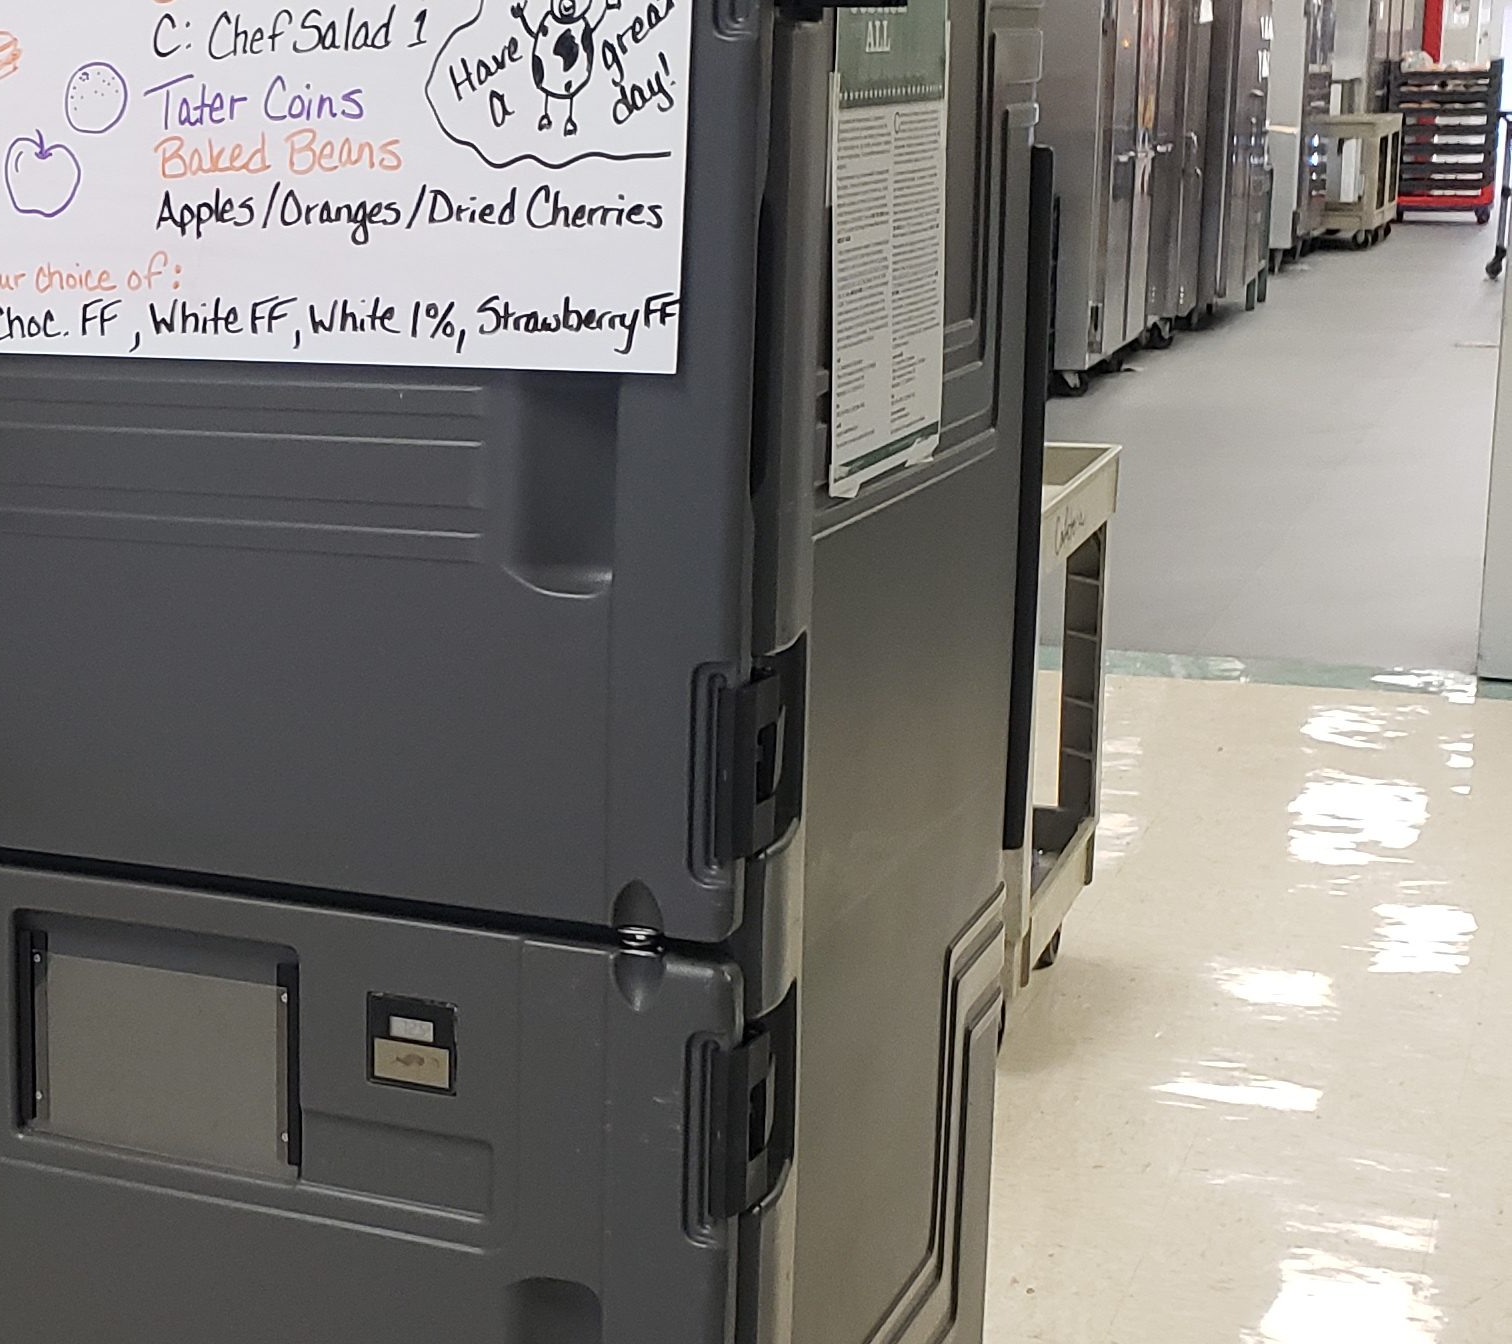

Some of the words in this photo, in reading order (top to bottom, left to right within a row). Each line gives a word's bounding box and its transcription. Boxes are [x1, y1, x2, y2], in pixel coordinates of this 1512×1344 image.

[153, 13, 191, 57] C:
[208, 9, 293, 59] Chef
[292, 4, 397, 54] Salad
[407, 8, 428, 48] 1
[865, 20, 891, 53] ALL
[449, 37, 523, 101] Have
[612, 52, 676, 124] day!
[144, 74, 248, 130] Tater
[264, 75, 365, 121] Coins
[489, 90, 515, 128] a
[154, 131, 272, 179] Baked
[284, 128, 403, 175] Beans
[527, 185, 664, 229] Cherries
[37, 262, 118, 294] choice
[149, 297, 244, 335] White
[309, 296, 402, 334] White
[477, 296, 639, 354] Strawberry
[644, 292, 680, 329] FF
